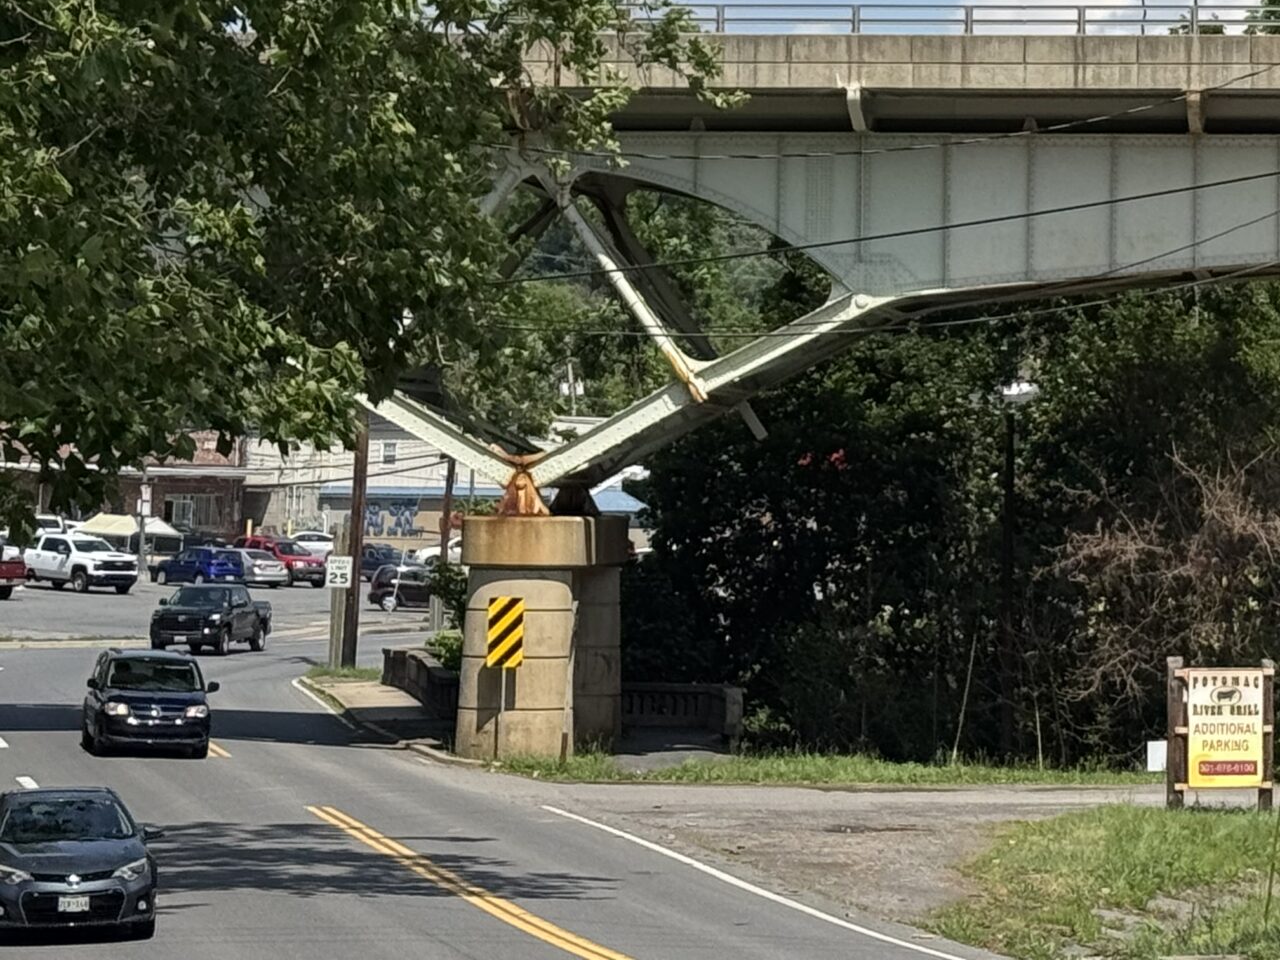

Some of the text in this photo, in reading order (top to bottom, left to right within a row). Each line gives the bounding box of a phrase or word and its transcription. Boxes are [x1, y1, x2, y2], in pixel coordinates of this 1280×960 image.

[329, 572, 348, 584] 25
[1192, 675, 1260, 689] POTOMAC
[1192, 703, 1260, 716] RIVER GRILL
[1193, 722, 1258, 735] ADDITIONAL
[1202, 739, 1250, 752] PARKING
